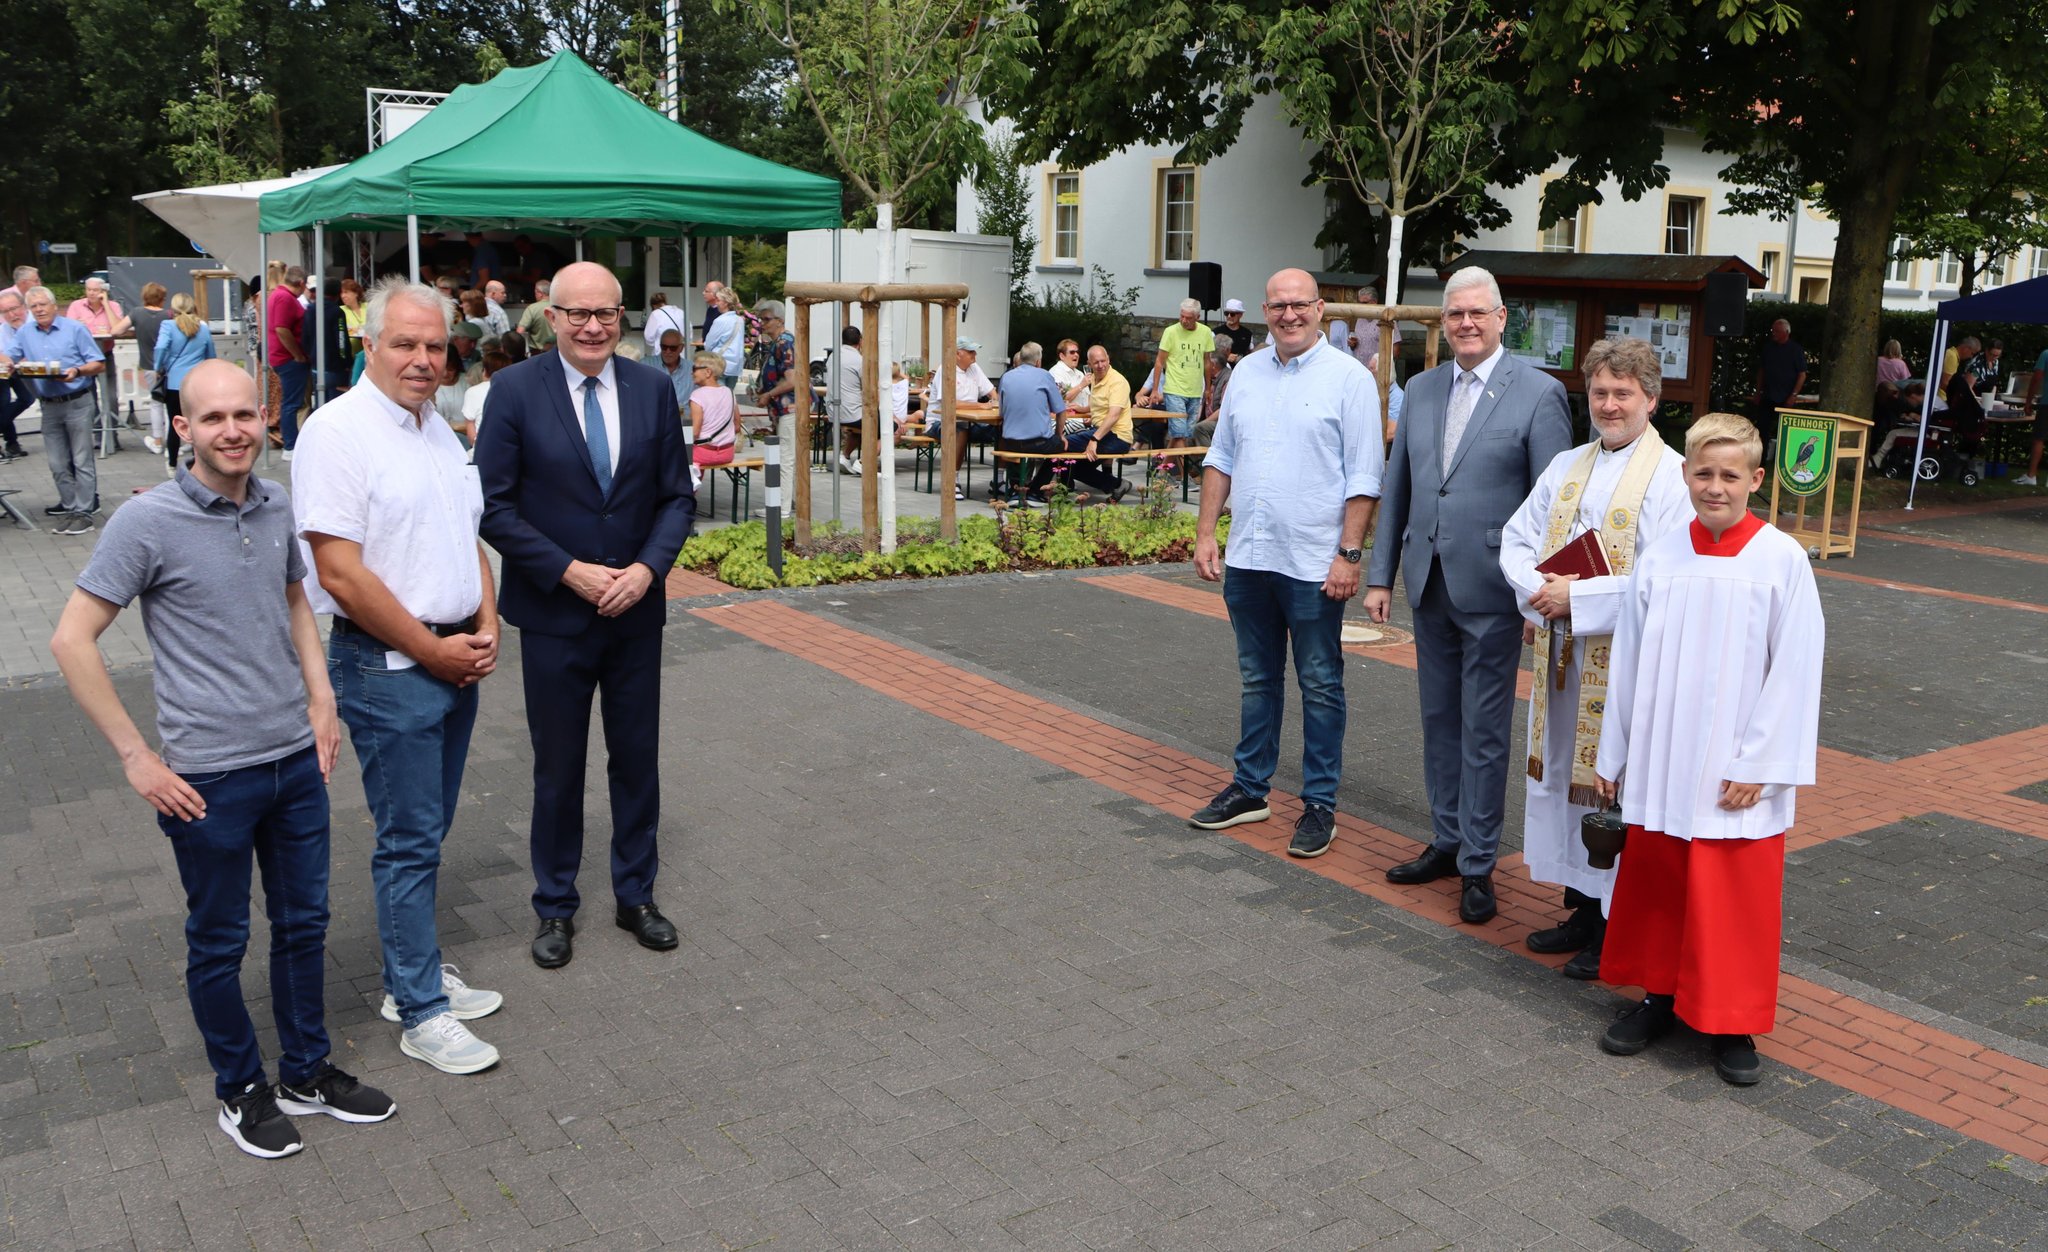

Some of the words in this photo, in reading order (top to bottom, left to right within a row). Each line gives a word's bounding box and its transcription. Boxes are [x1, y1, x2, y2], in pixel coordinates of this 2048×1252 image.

[1783, 416, 1834, 431] STEINHORST
[1581, 536, 1600, 576] BENEDIKTIONAL
[1582, 672, 1608, 687] Mar
